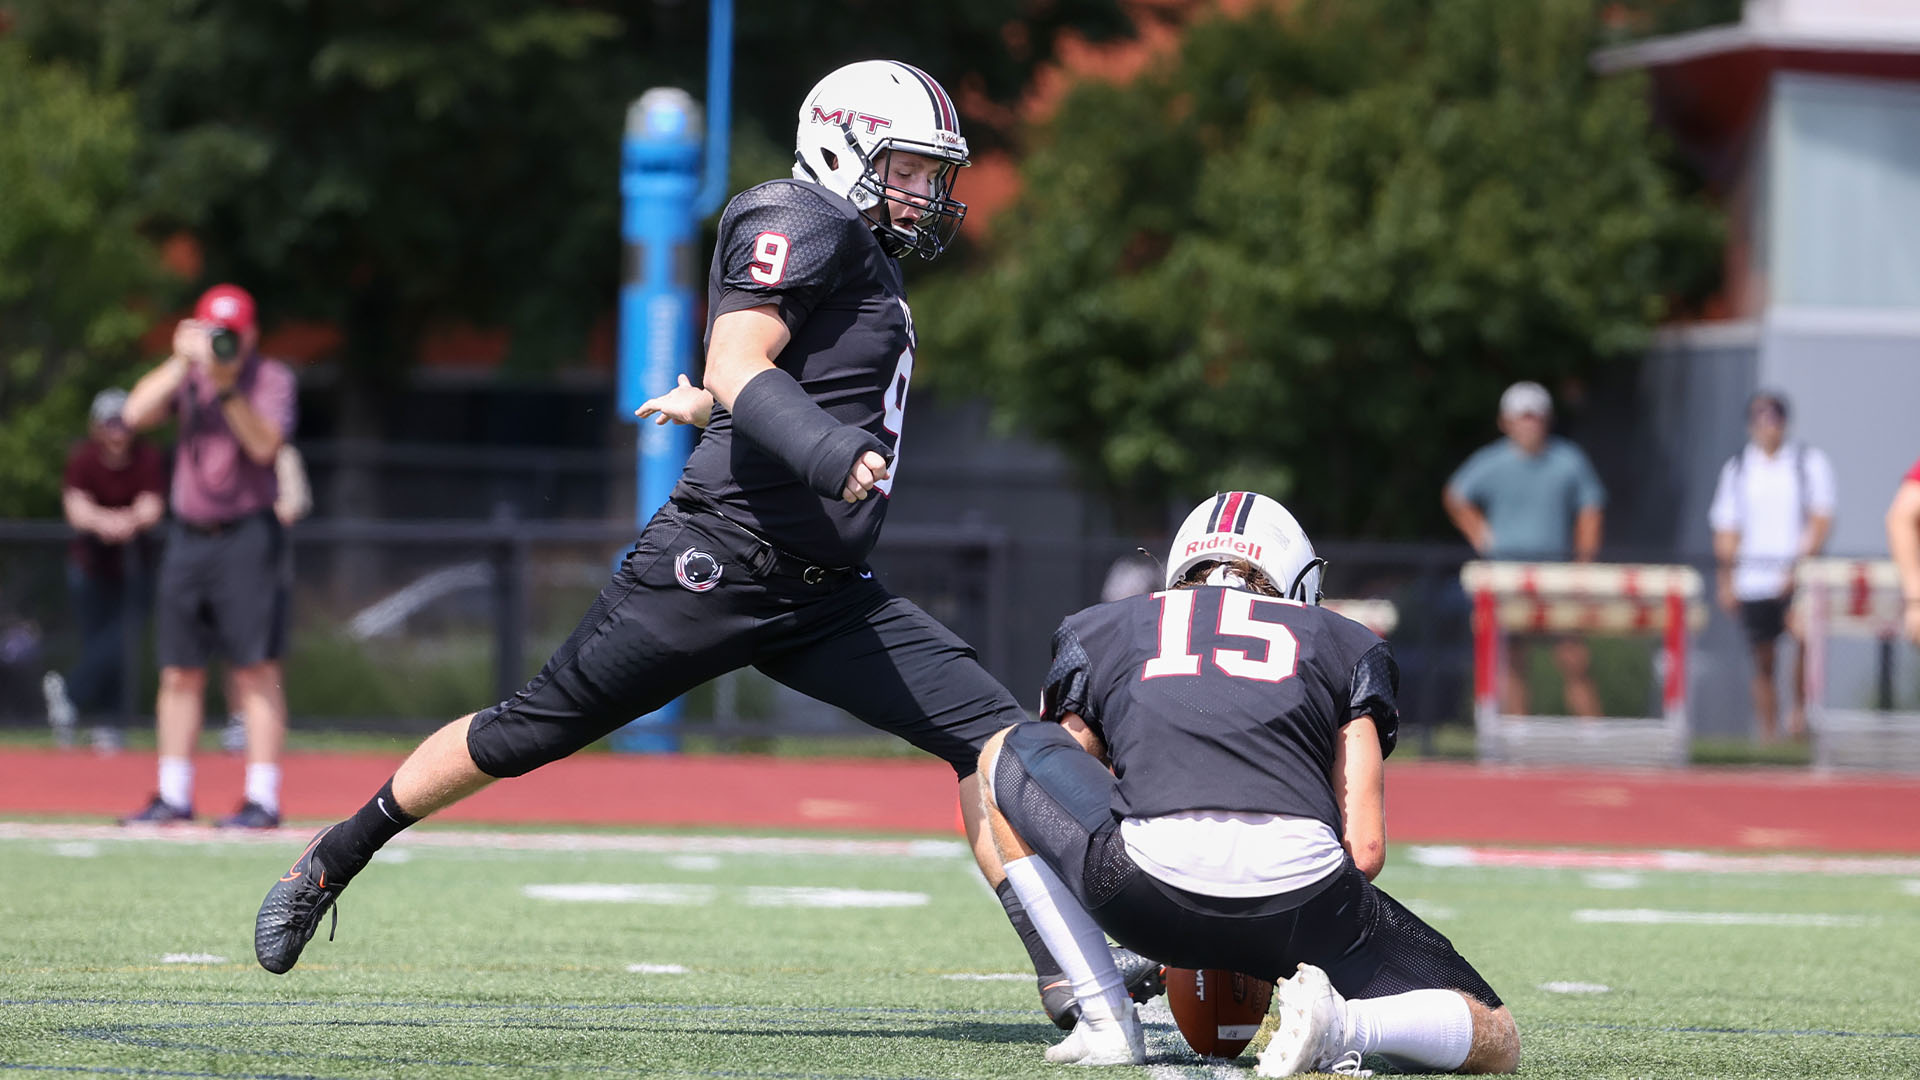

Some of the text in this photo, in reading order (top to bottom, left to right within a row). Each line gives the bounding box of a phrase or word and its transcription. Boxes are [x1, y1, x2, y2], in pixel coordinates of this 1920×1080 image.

[811, 105, 892, 135] MIT
[748, 230, 791, 287] 9
[1185, 536, 1262, 560] Riddell
[1141, 588, 1307, 683] 15
